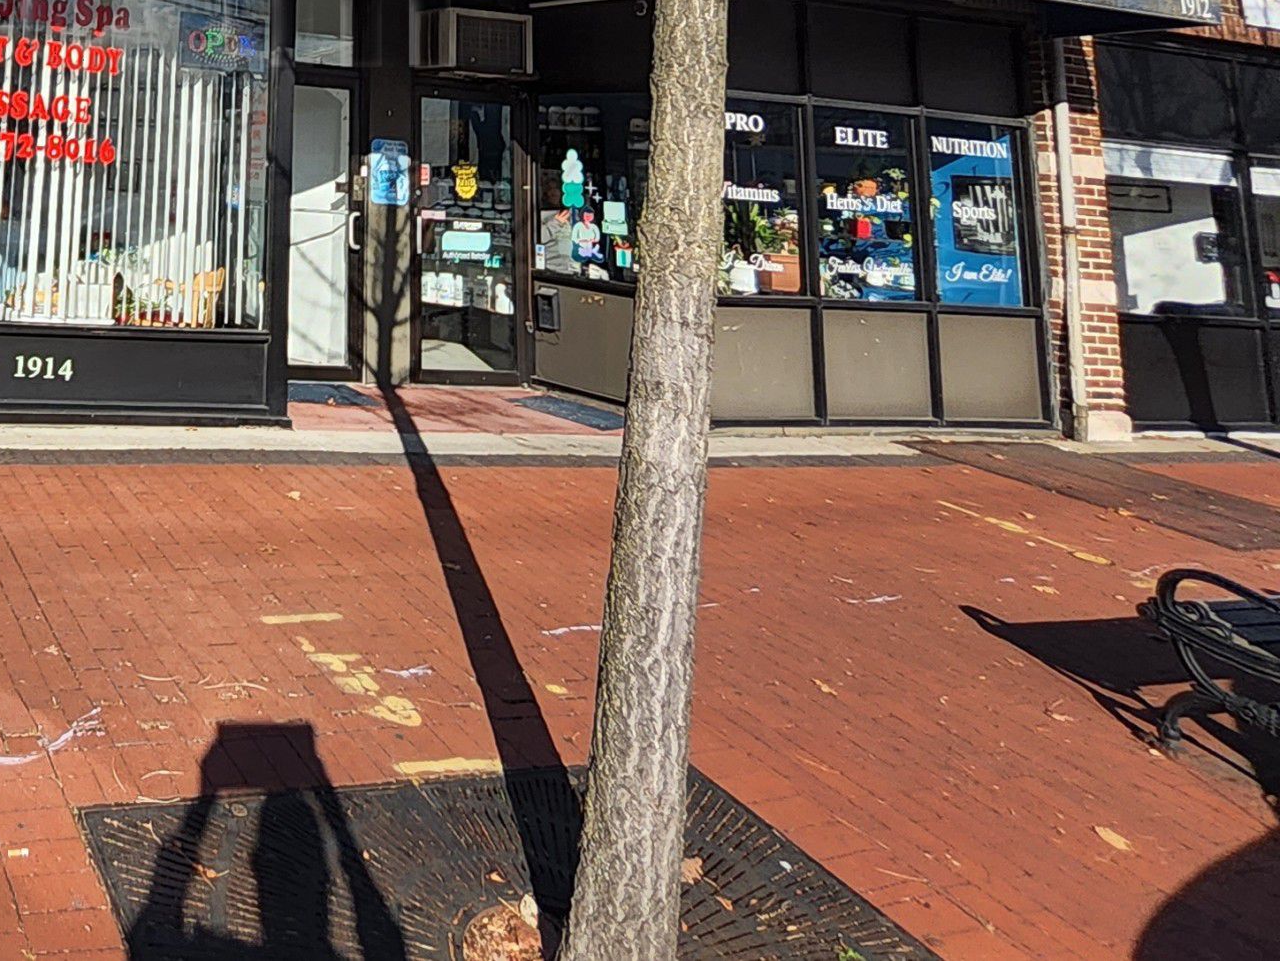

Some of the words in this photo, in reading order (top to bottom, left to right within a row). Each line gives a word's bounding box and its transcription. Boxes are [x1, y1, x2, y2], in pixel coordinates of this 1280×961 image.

[15, 36, 39, 66] &
[46, 39, 123, 75] BODY
[724, 112, 764, 133] PRO
[834, 126, 890, 149] ELITE
[930, 136, 1008, 159] NUTRITION
[875, 196, 904, 213] Diet
[952, 201, 997, 221] Sports
[945, 261, 966, 282] I
[13, 355, 74, 382] 1914
